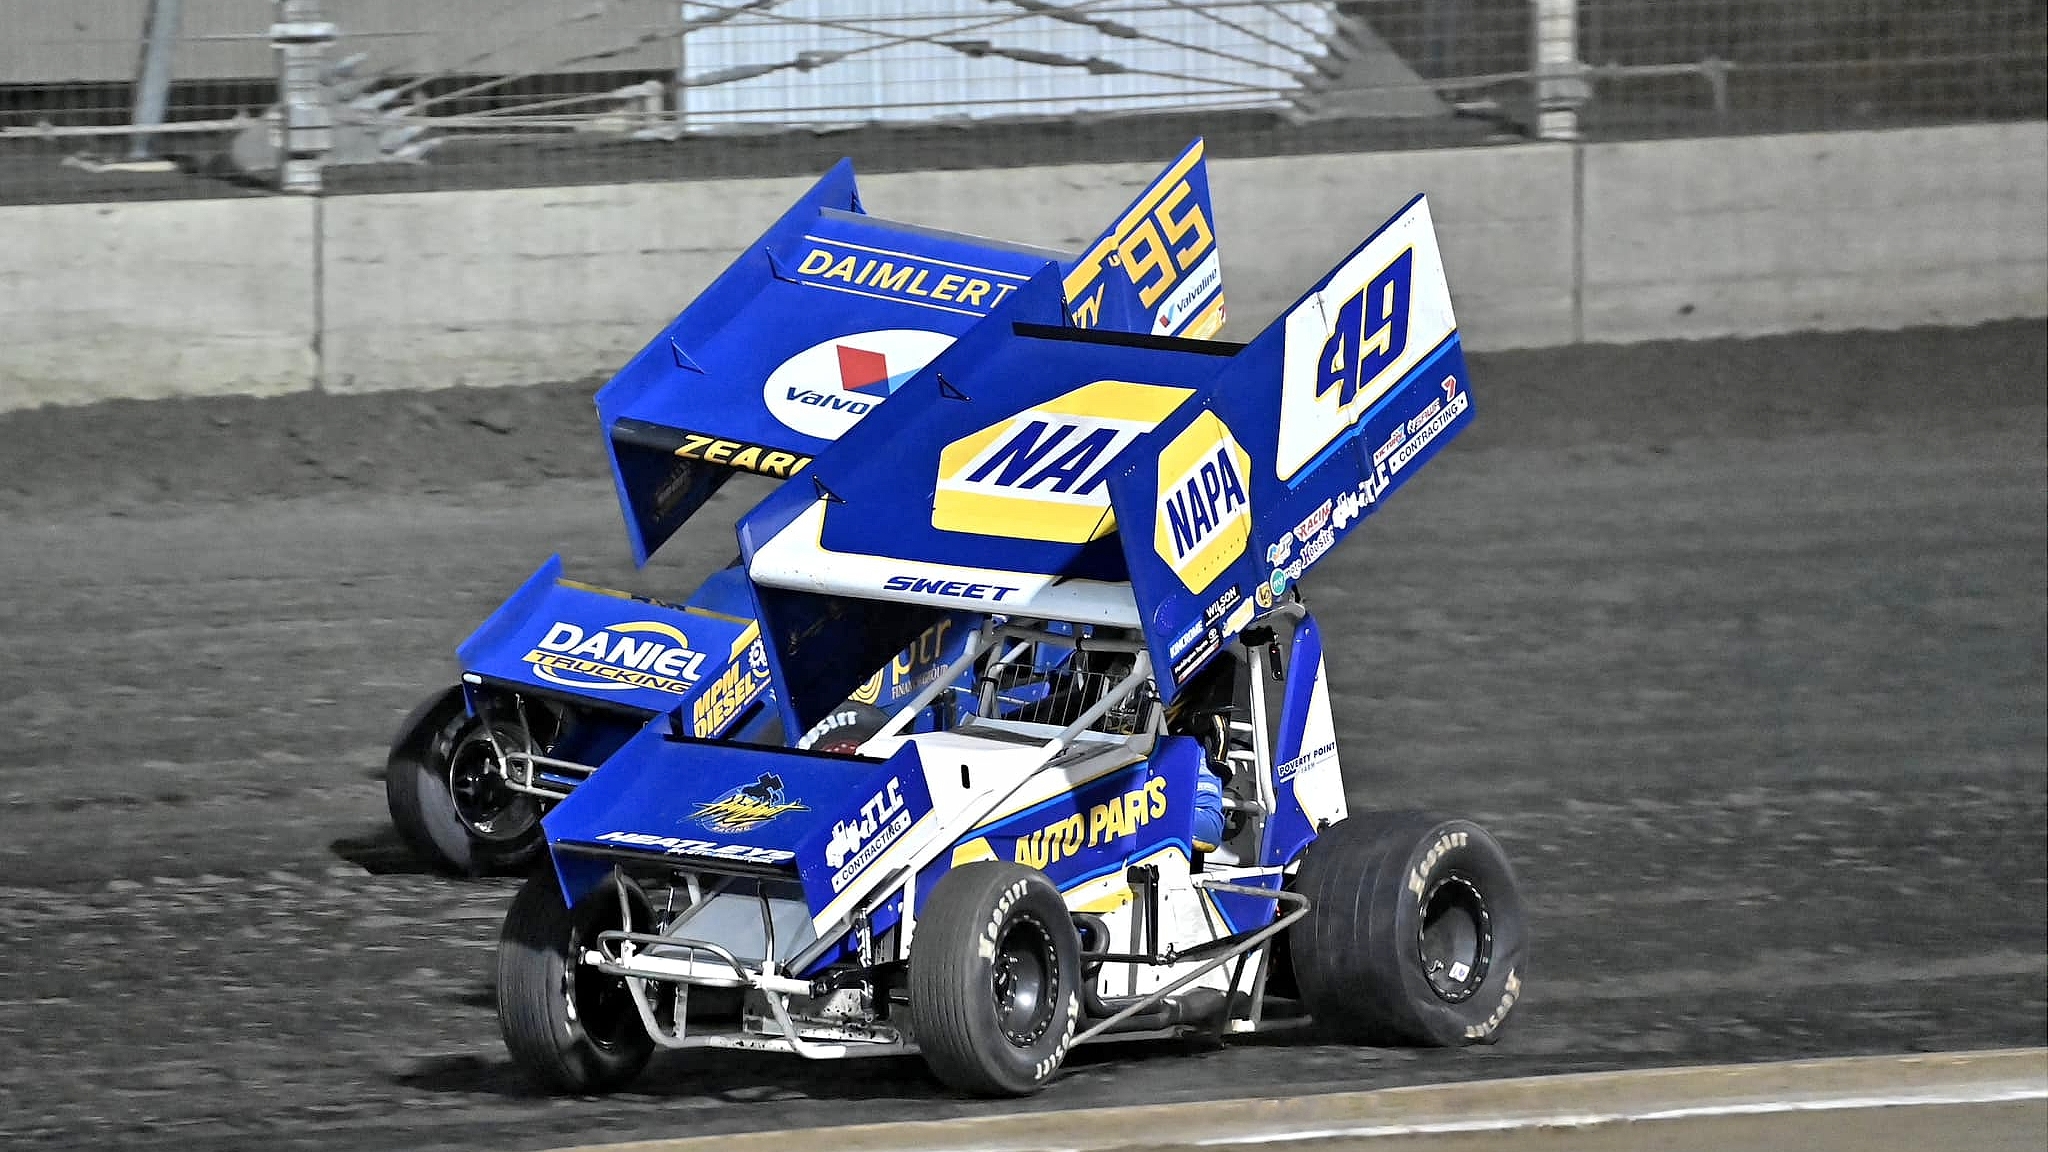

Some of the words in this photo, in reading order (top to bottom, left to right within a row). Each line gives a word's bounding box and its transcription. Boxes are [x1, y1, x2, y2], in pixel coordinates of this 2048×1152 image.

[1177, 268, 1217, 313] Valvoline
[1315, 246, 1413, 408] 49
[786, 386, 871, 415] Valvo
[1399, 403, 1459, 462] CONTRACTING
[1166, 447, 1247, 560] NAPA
[883, 575, 1021, 602] SWEET
[1205, 586, 1237, 618] WILSON
[534, 651, 693, 694] TRUCKING
[537, 621, 707, 682] DANIEL
[694, 660, 740, 725] MPM
[694, 671, 756, 738] DIESEL
[1279, 752, 1311, 775] POVERTY
[1313, 741, 1335, 758] POINT
[860, 776, 904, 836] TLC
[1014, 813, 1085, 871] AUTO
[1088, 775, 1168, 848] PARTS
[595, 831, 796, 861] HEATLEYS
[842, 821, 902, 881] CONTRACTING
